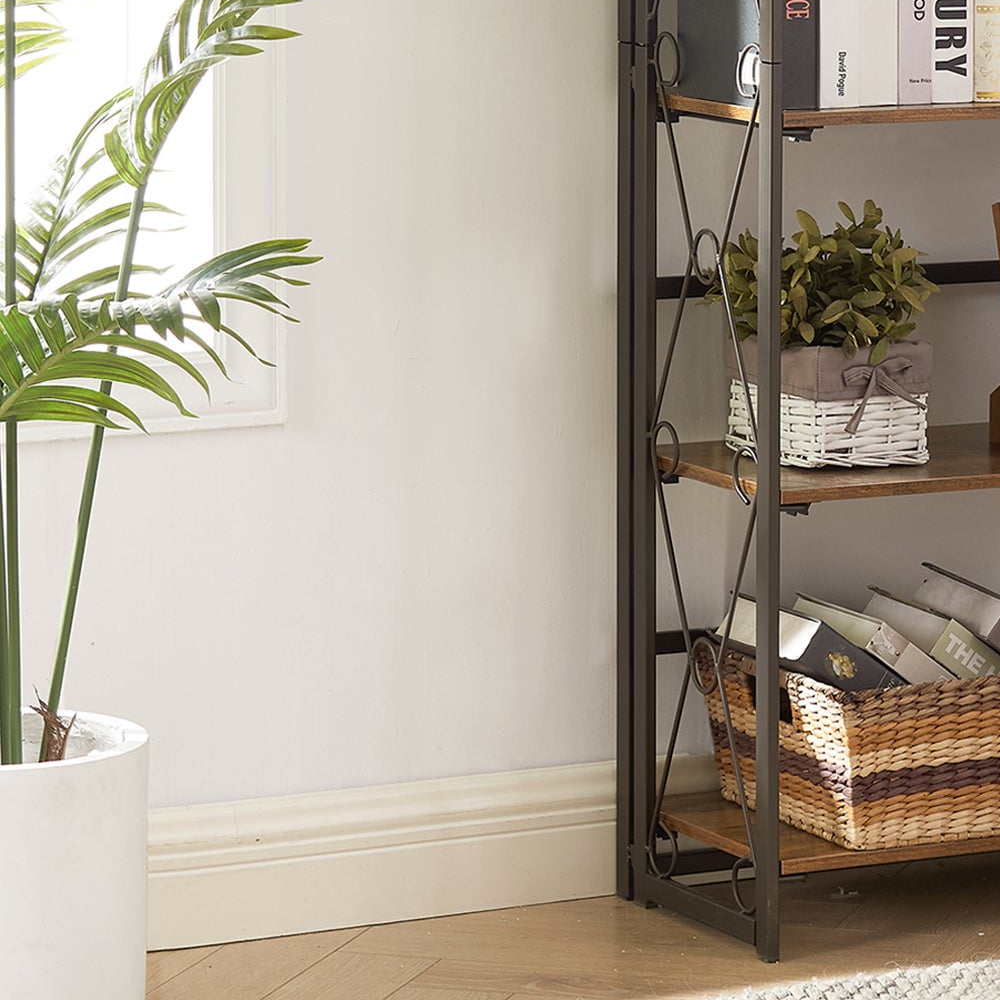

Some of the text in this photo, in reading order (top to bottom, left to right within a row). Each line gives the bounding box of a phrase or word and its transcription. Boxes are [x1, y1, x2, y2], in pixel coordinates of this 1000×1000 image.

[836, 51, 847, 97] David Pogue
[944, 633, 986, 675] THE
